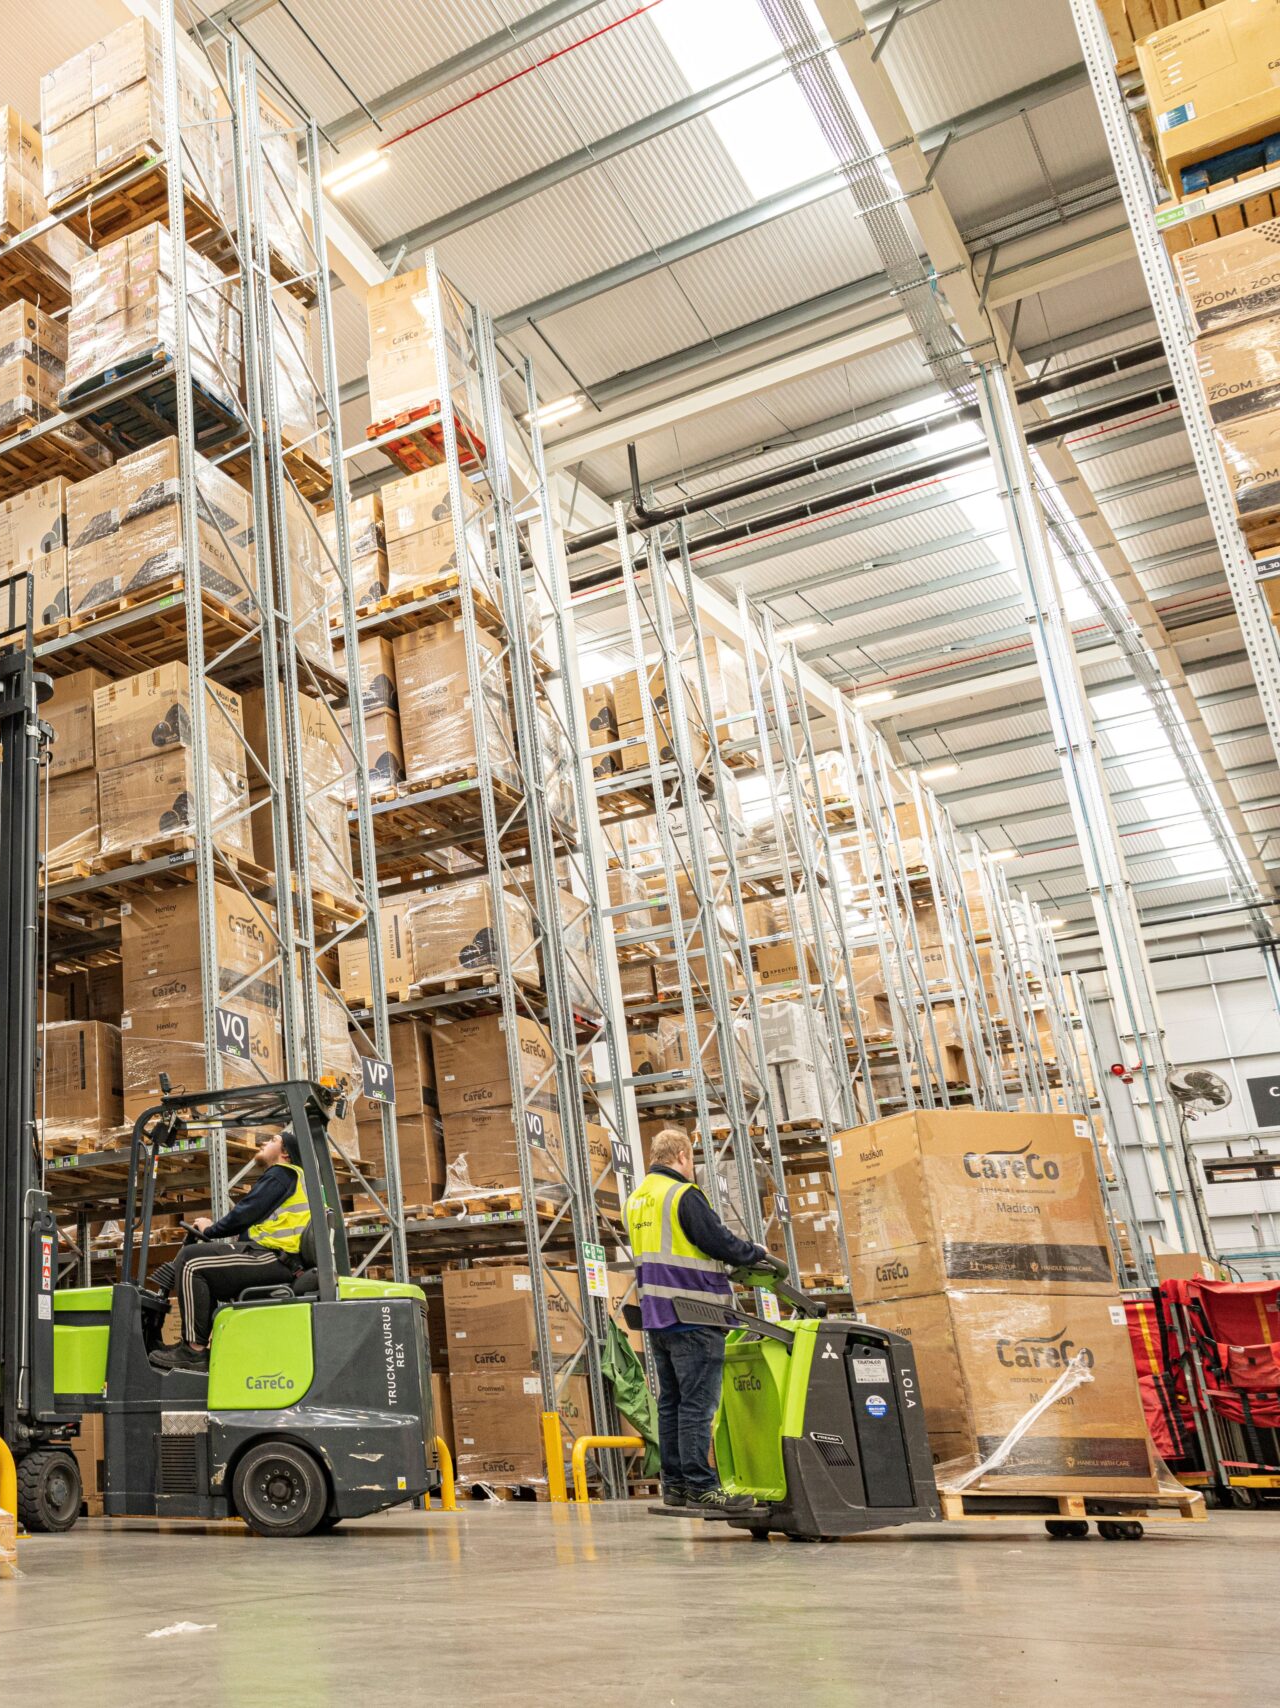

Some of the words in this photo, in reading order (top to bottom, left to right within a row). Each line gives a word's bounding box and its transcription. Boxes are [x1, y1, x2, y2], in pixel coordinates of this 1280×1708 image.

[1195, 288, 1238, 309] ZOOM
[392, 329, 418, 345] CareCo
[1208, 379, 1253, 401] ZOOM
[200, 540, 226, 561] -TECH
[219, 701, 239, 716] mfort
[155, 903, 177, 914] Henley
[228, 914, 265, 944] CareCo
[322, 950, 339, 961] Care
[152, 978, 187, 998] CareCo
[156, 1021, 178, 1031] Henley
[218, 1011, 245, 1049] VQ
[250, 1031, 270, 1060] eCo
[520, 1038, 547, 1060] CareCo
[70, 1044, 80, 1092] CELESTE
[366, 1060, 389, 1087] VP
[463, 1087, 493, 1103] CareCo
[525, 1113, 542, 1136] VO
[588, 1137, 608, 1159] areCo
[613, 1141, 631, 1164] VN
[859, 1148, 884, 1163] Madison
[963, 1140, 1060, 1181] CareCo
[775, 1196, 789, 1213] VL
[996, 1202, 1041, 1216] Madison
[876, 1257, 910, 1283] CareCo
[1077, 1265, 1092, 1273] CARE
[469, 1279, 496, 1288] Cromwell
[894, 1326, 912, 1337] dison
[381, 1305, 398, 1406] TRUCKASAURUS
[396, 1343, 405, 1368] REX
[474, 1350, 506, 1365] CareCo
[996, 1326, 1095, 1369] CareCo
[245, 1371, 295, 1390] CareCo
[477, 1384, 505, 1393] Cromwell
[733, 1368, 762, 1392] CareCo
[900, 1368, 917, 1409] LOLA
[1029, 1392, 1075, 1406] Mson
[482, 1459, 516, 1474] CareCo
[1076, 1460, 1099, 1468] HANDLE
[1099, 1460, 1114, 1468] WITH
[1114, 1460, 1131, 1468] CARE
